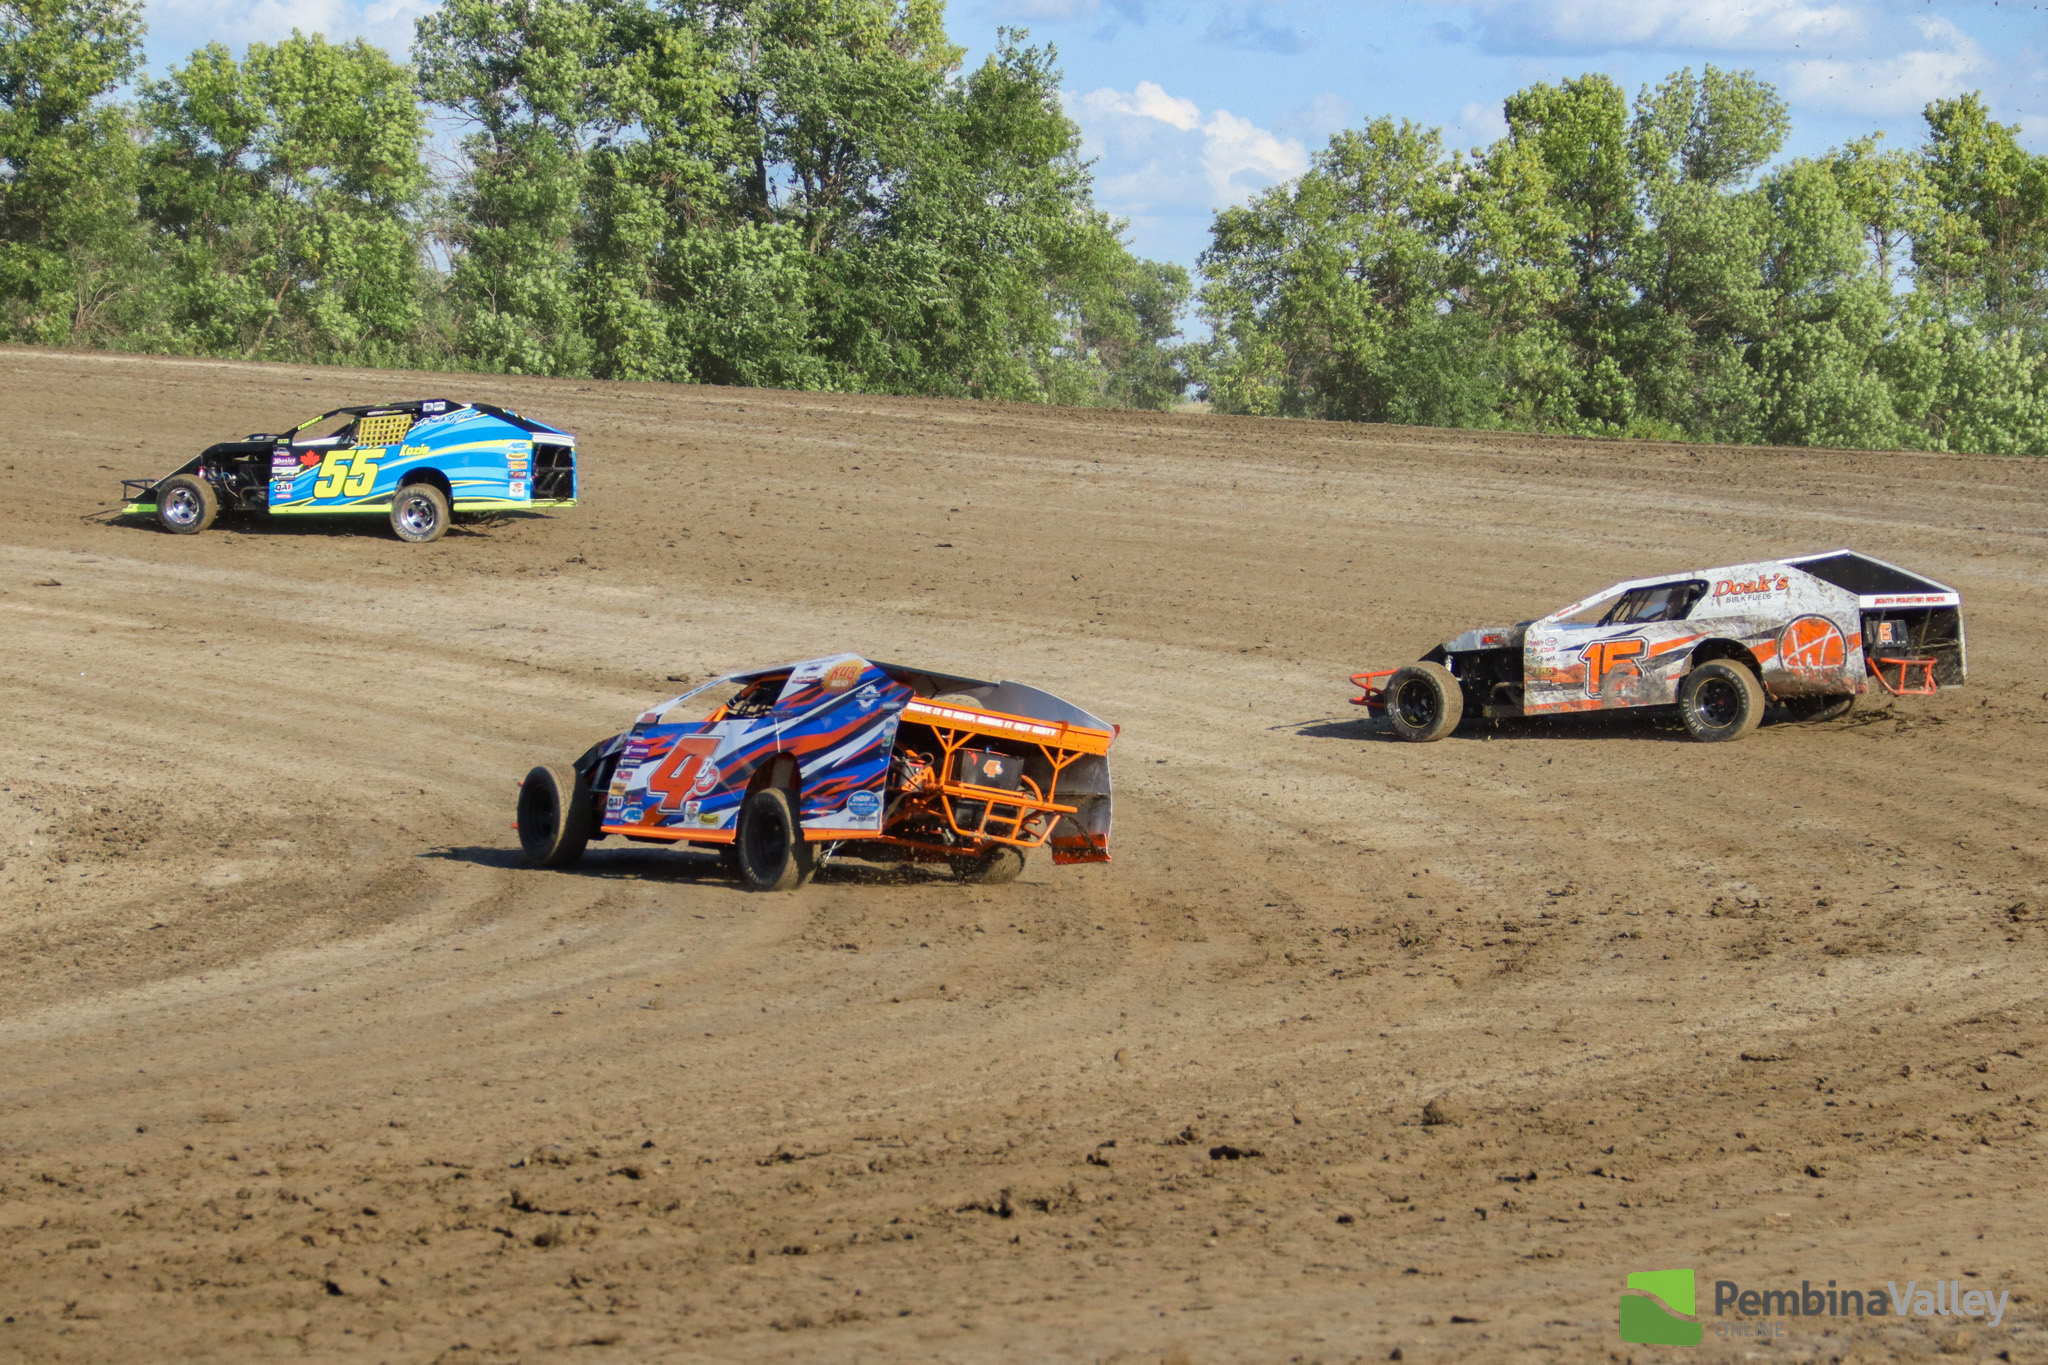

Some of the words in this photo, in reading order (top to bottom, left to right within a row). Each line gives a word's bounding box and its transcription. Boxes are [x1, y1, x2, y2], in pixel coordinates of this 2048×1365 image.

[399, 443, 430, 456] Kozie
[313, 448, 386, 499] 55
[1713, 573, 1789, 597] Doak's
[1747, 593, 1772, 601] FUELS
[830, 666, 858, 680] KUB
[907, 702, 932, 714] DRIVE
[932, 706, 942, 716] IT
[953, 710, 977, 723] DEEP,
[977, 715, 1004, 727] BRING
[1004, 720, 1014, 729] IT
[1014, 721, 1032, 732] OUT
[1032, 725, 1057, 737] DIRTY
